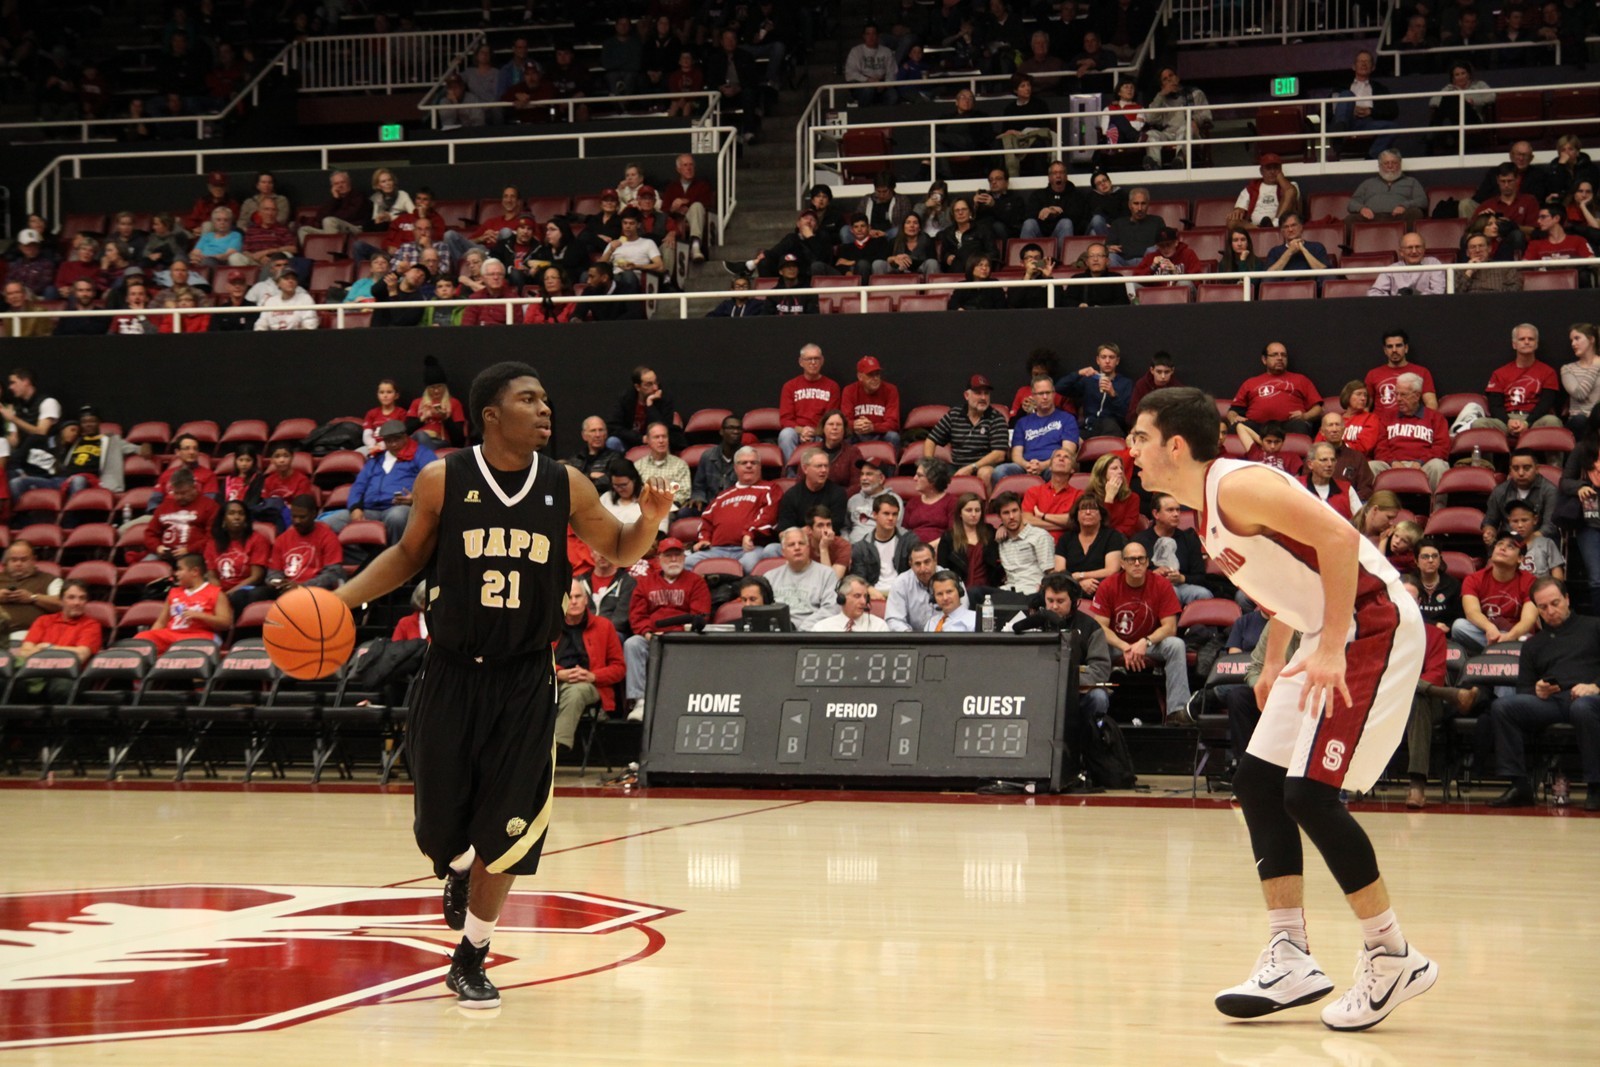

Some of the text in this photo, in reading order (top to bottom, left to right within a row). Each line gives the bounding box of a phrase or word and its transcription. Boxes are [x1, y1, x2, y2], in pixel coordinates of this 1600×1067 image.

[1275, 78, 1296, 95] EXIT
[794, 388, 831, 403] STANFORD
[1025, 426, 1049, 442] Kansas
[463, 527, 551, 565] UAPB
[481, 569, 521, 609] 21
[649, 589, 685, 606] STANFORD
[687, 693, 742, 713] HOME
[825, 703, 878, 719] PERIOD
[963, 695, 1025, 716] GUEST
[786, 736, 799, 754] B
[898, 737, 910, 756] B
[1322, 739, 1346, 772] S
